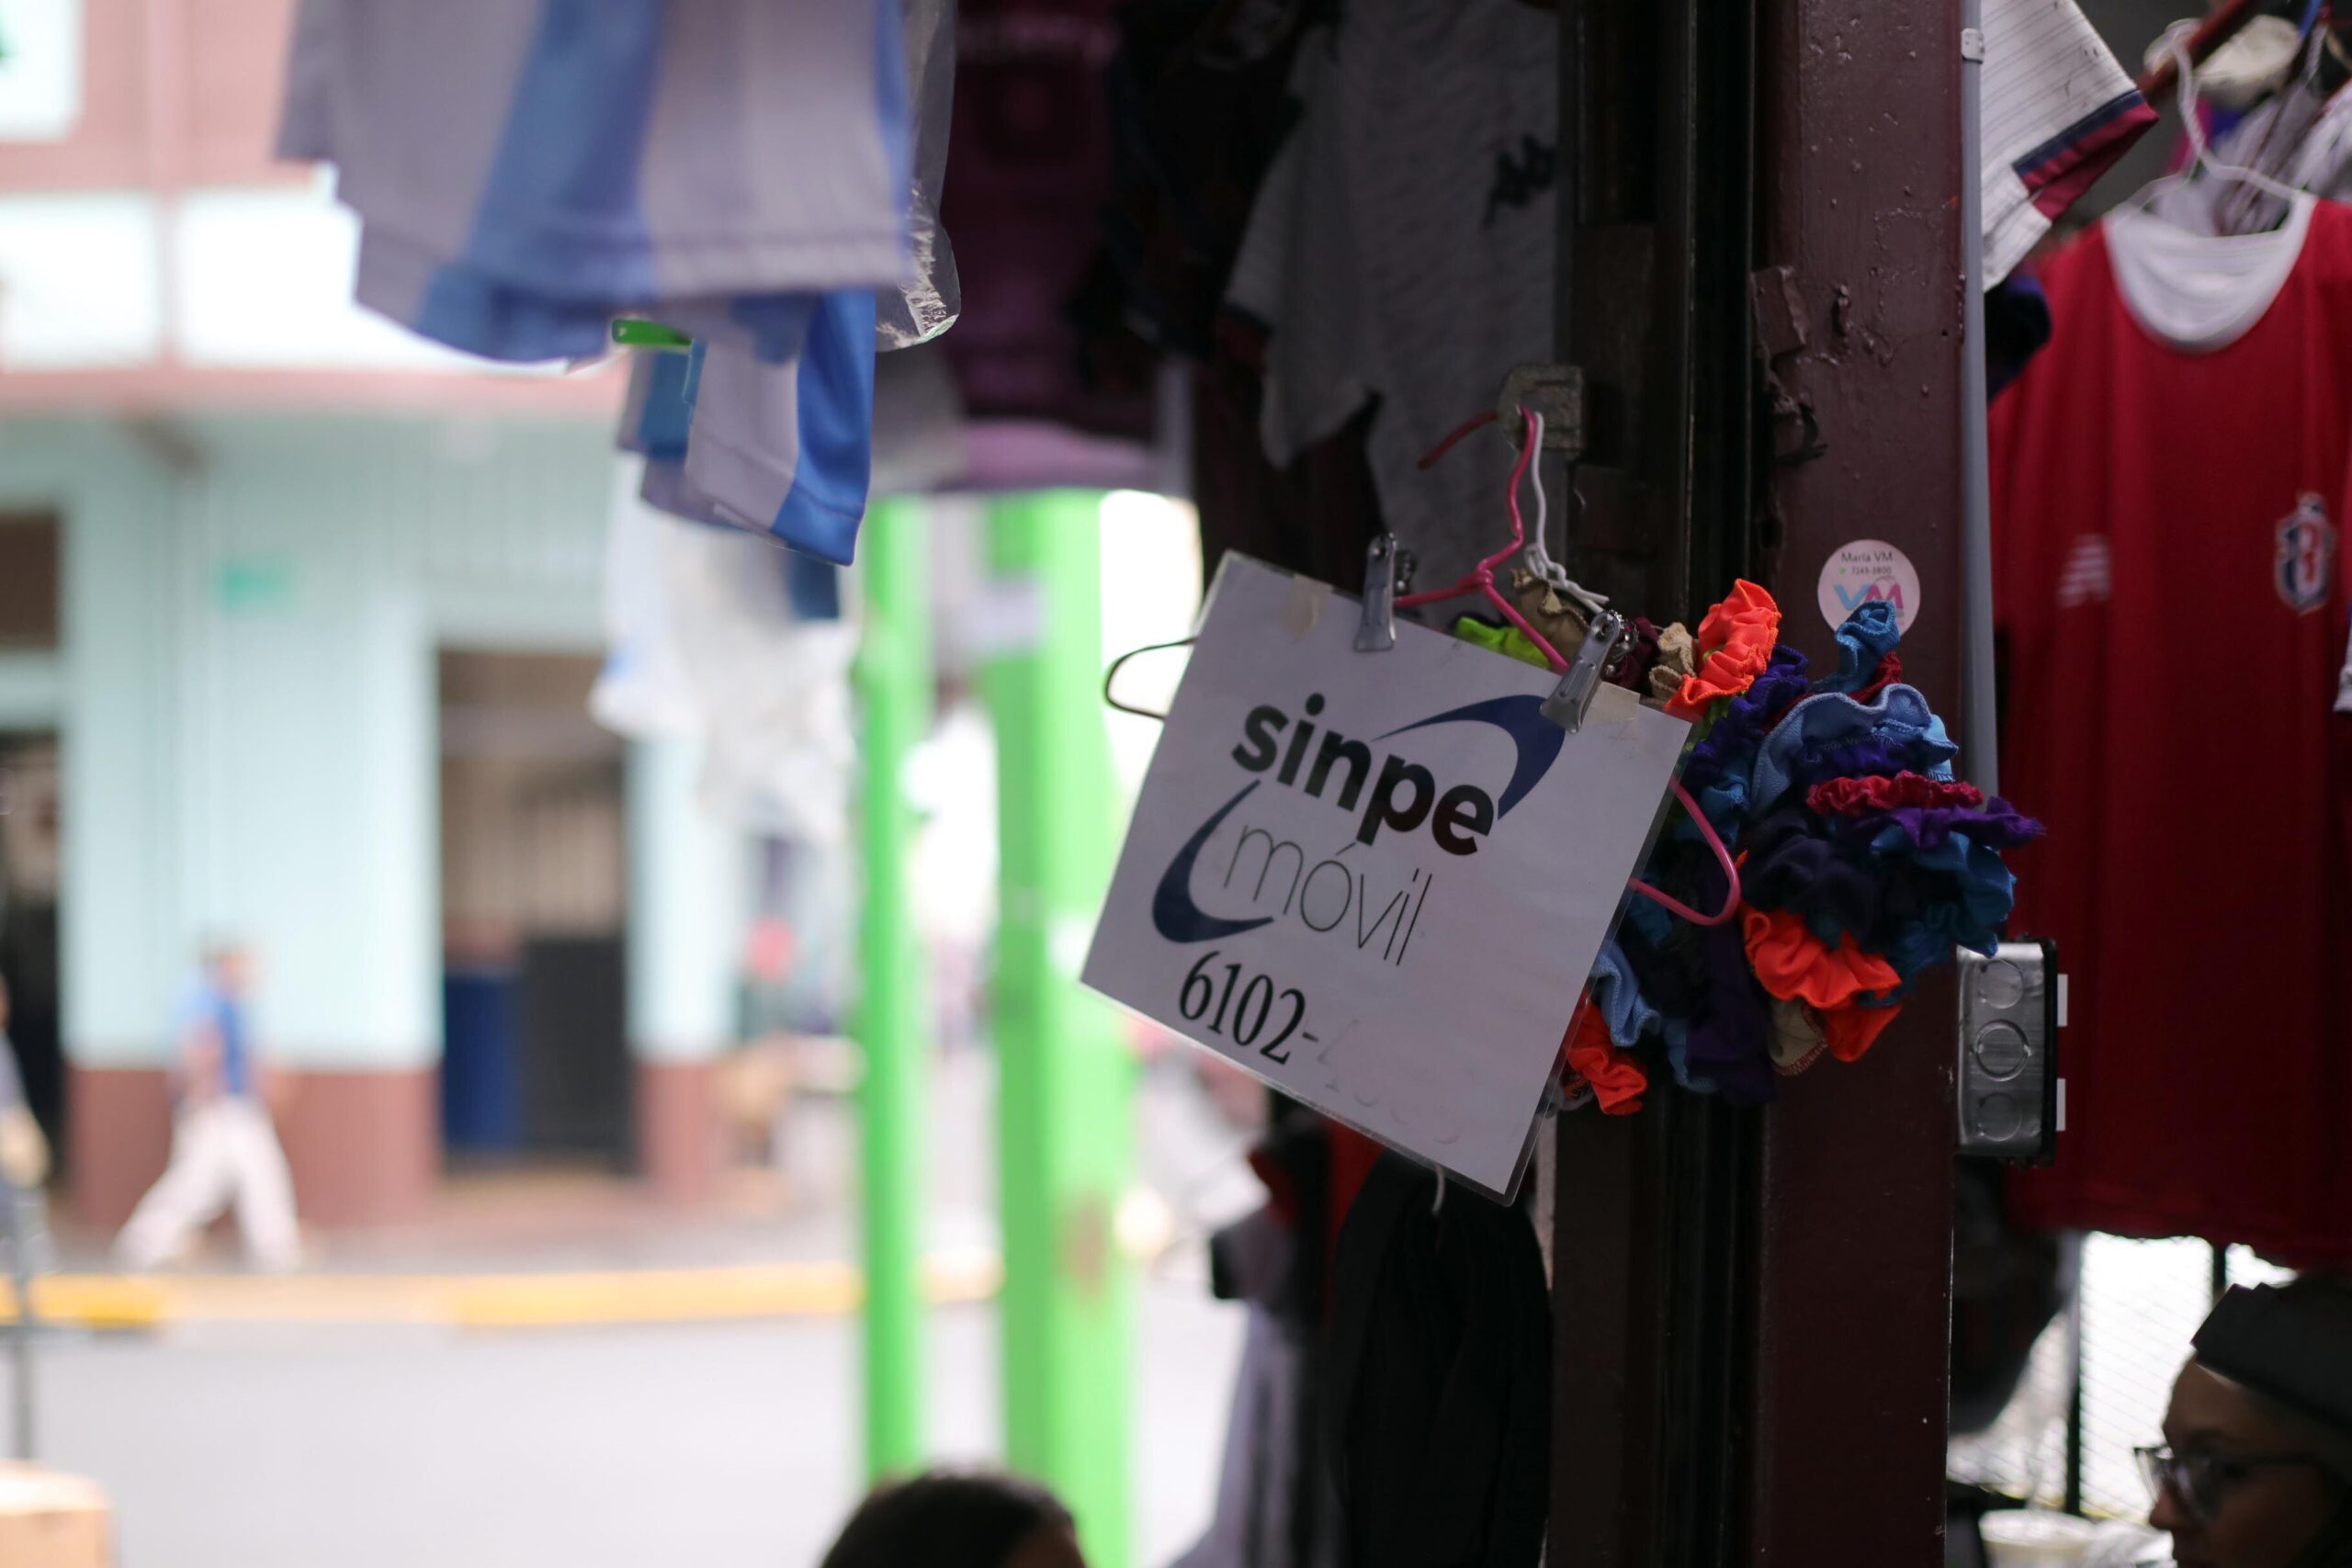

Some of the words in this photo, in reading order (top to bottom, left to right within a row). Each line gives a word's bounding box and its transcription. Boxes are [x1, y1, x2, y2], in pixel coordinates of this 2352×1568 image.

[1874, 551, 1893, 562] VM
[1231, 693, 1495, 856] sinpe
[1223, 824, 1432, 966] móvil
